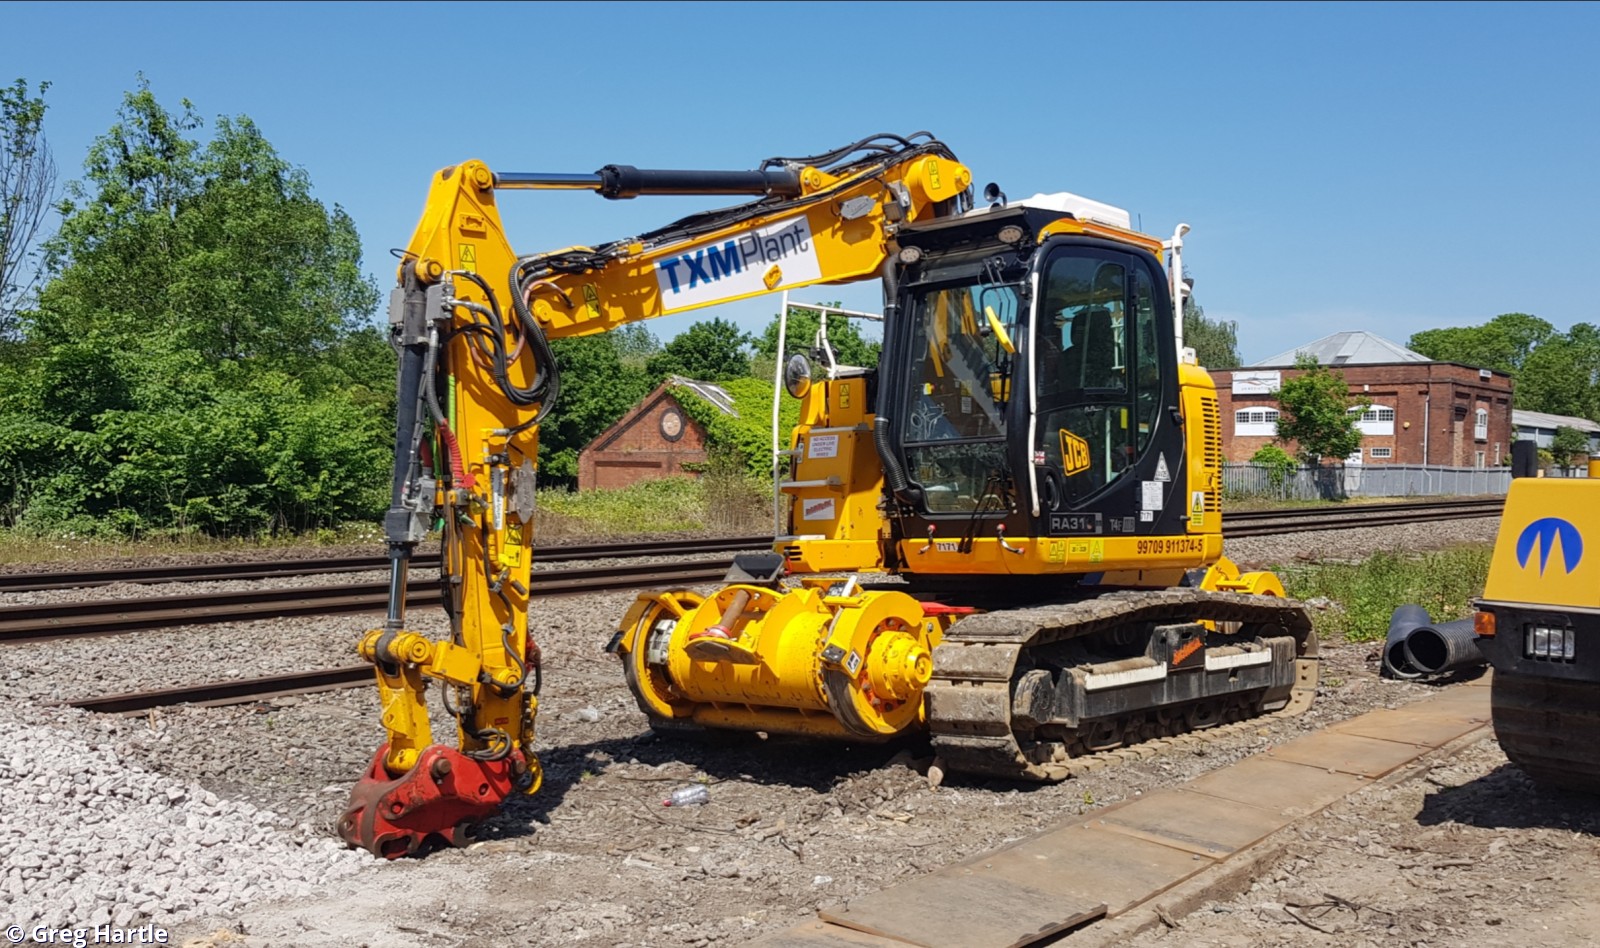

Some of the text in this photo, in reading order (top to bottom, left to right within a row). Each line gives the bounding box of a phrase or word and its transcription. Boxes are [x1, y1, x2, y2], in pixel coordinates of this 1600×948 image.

[1065, 435, 1088, 471] JCB
[936, 542, 956, 551] 7171
[1137, 539, 1203, 554] 99709 911374-5
